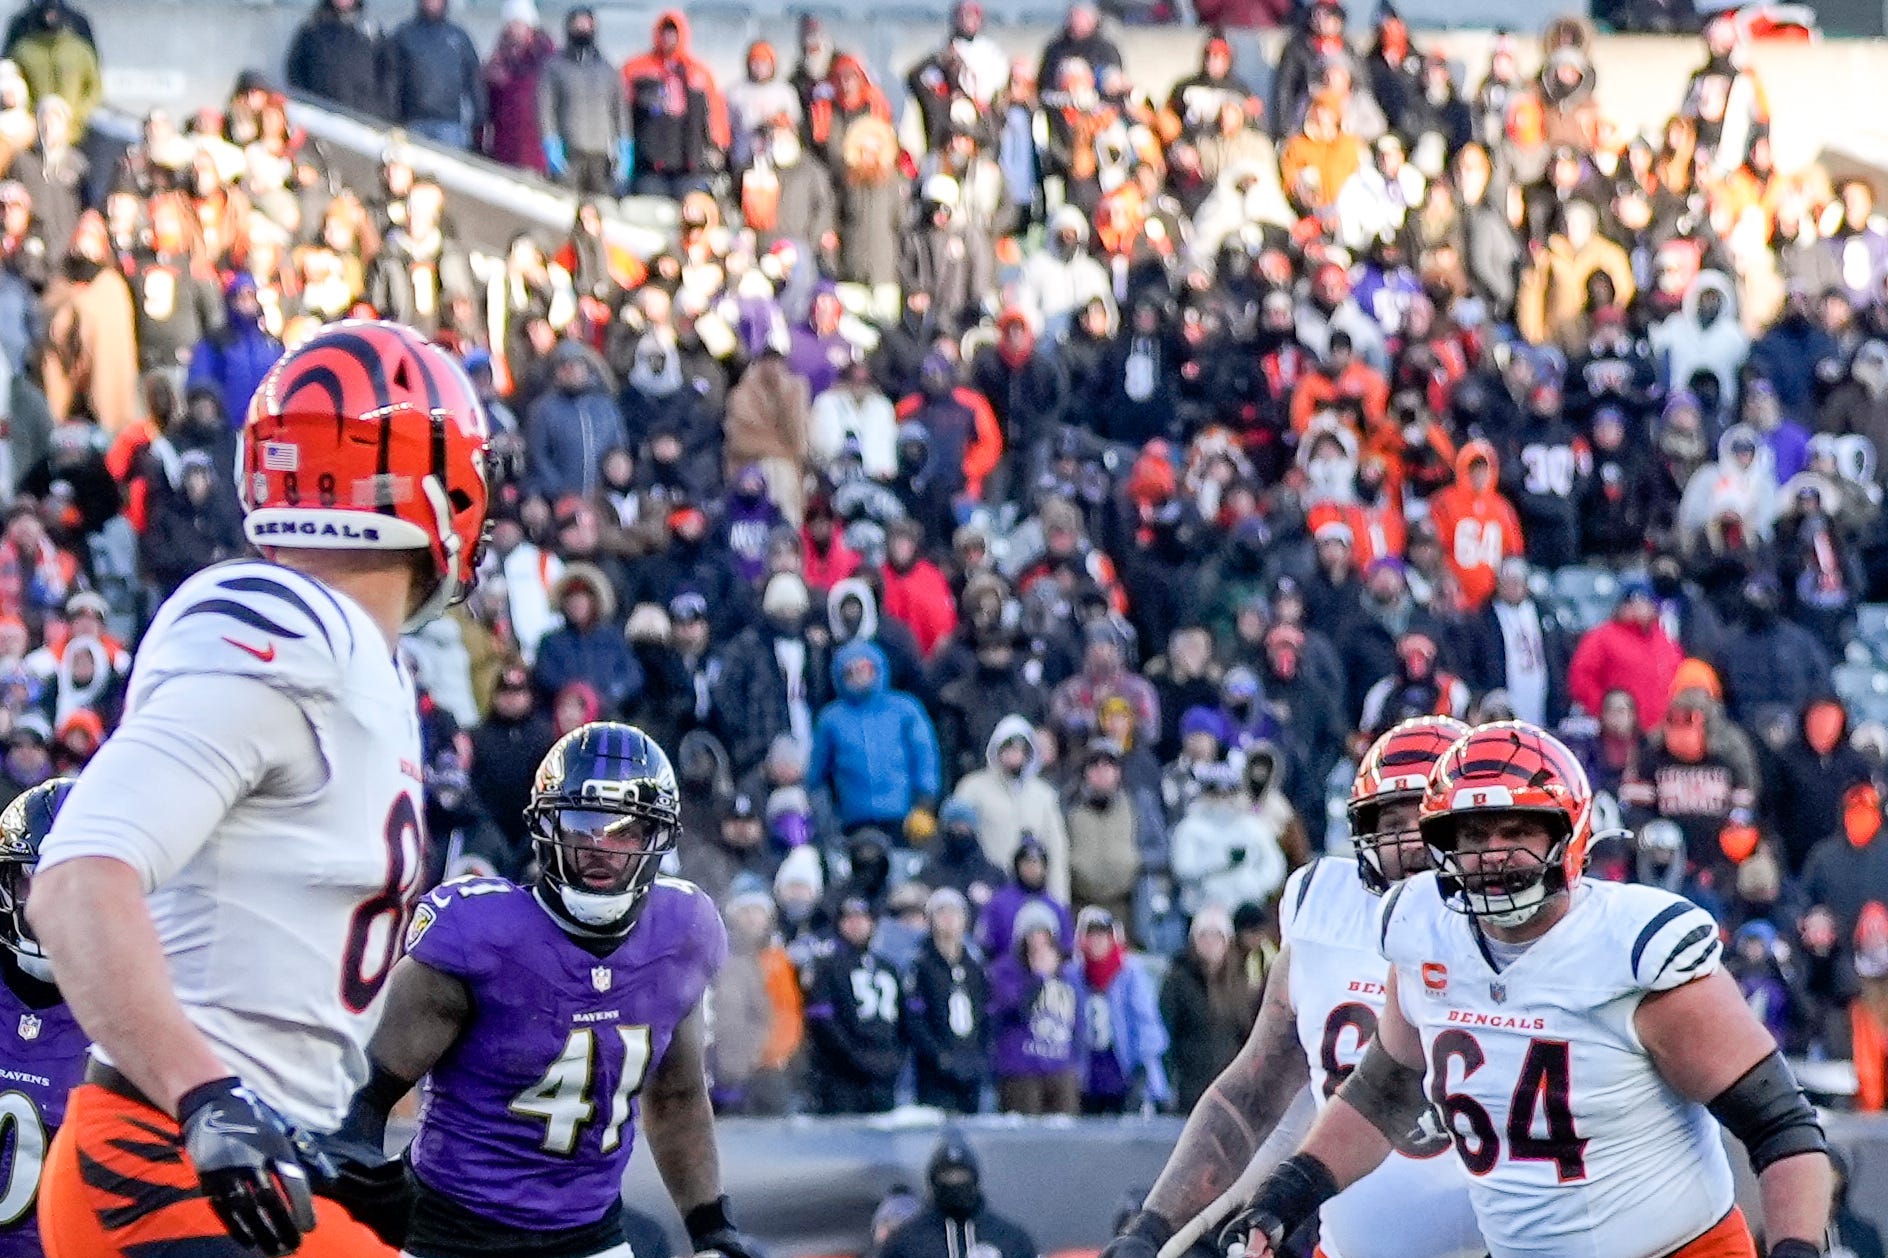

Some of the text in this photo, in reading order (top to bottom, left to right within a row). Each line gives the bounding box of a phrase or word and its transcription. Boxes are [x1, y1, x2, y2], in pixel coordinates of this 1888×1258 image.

[254, 521, 380, 541] BENGALS
[1422, 962, 1448, 989] C
[572, 1009, 620, 1023] RAVENS
[1447, 1009, 1546, 1031] BENGALS
[509, 1024, 651, 1154] 41
[1431, 1029, 1591, 1183] 64
